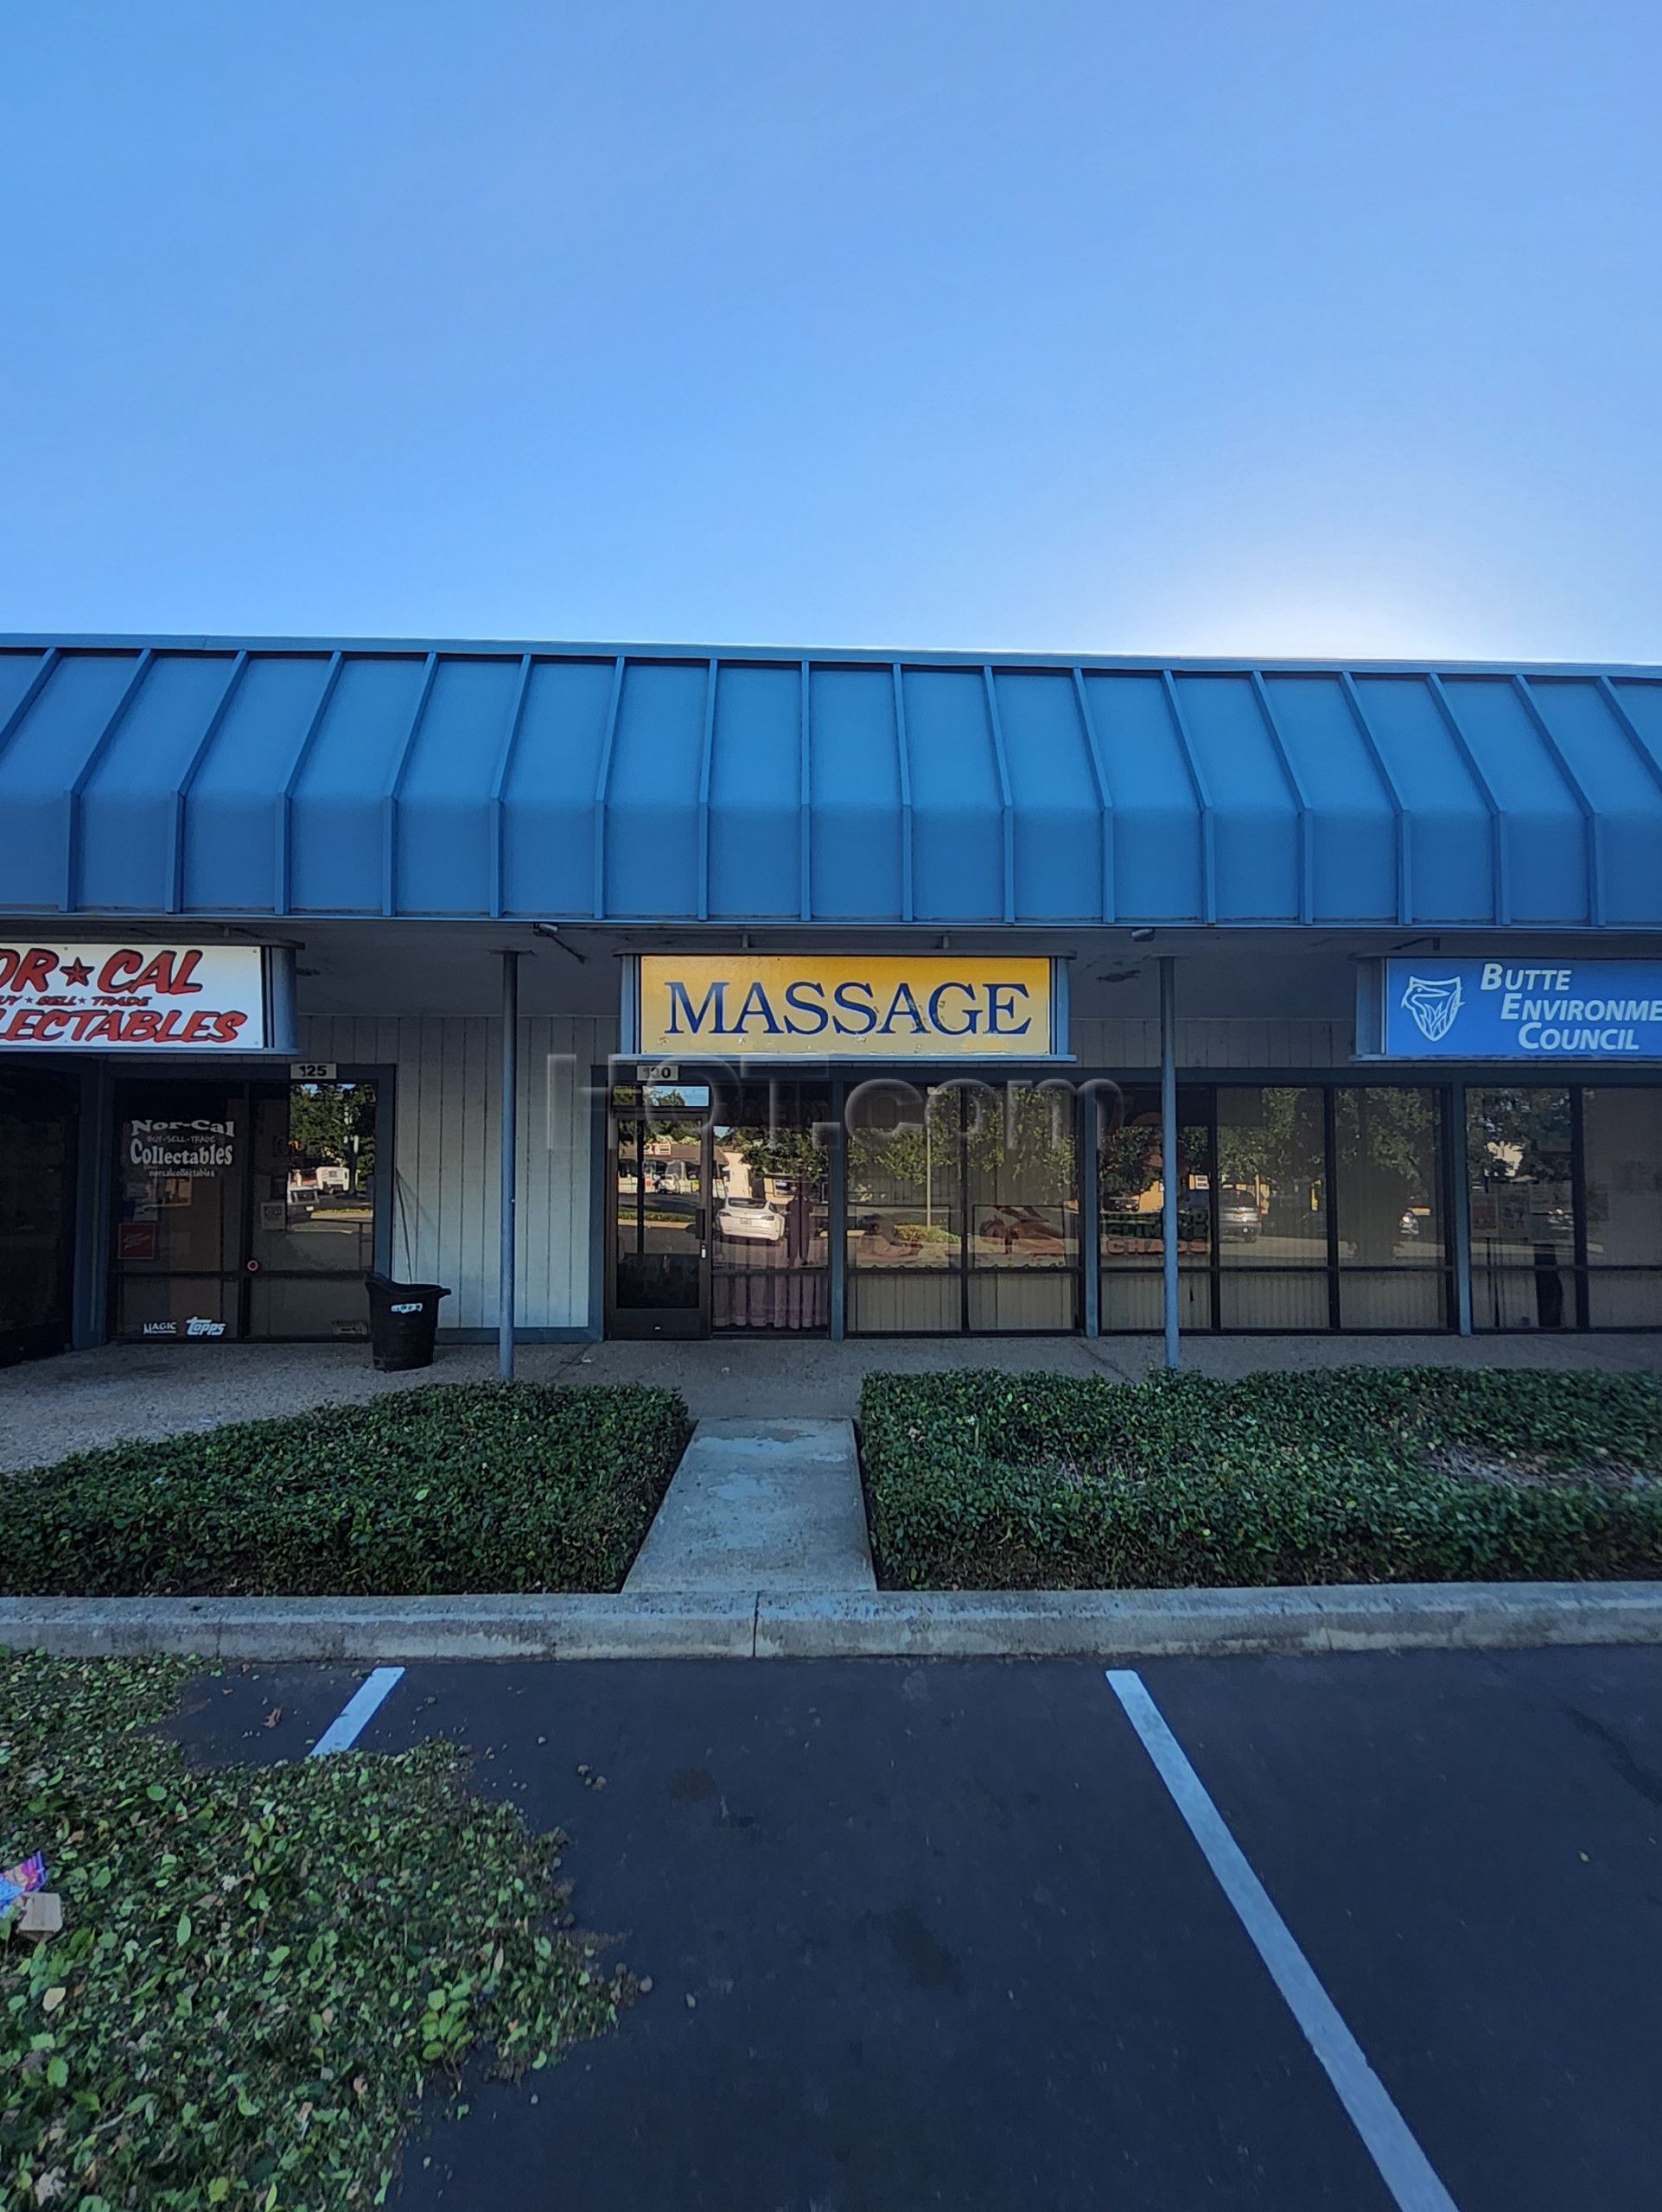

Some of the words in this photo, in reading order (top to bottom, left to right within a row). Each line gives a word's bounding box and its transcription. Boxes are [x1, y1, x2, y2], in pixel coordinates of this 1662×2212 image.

[97, 949, 203, 995] CAL
[1481, 963, 1572, 991] BUTTE
[35, 995, 78, 1006] SELL
[92, 996, 152, 1007] TRADE
[664, 981, 1032, 1036] MASSAGE
[0, 1008, 248, 1044] ECTABLES
[1518, 1022, 1640, 1051] COUNCIL
[298, 1065, 328, 1077] 125
[131, 1119, 236, 1138] Nor-Cal
[130, 1137, 233, 1166] Collectables
[143, 1321, 178, 1335] MAGIC
